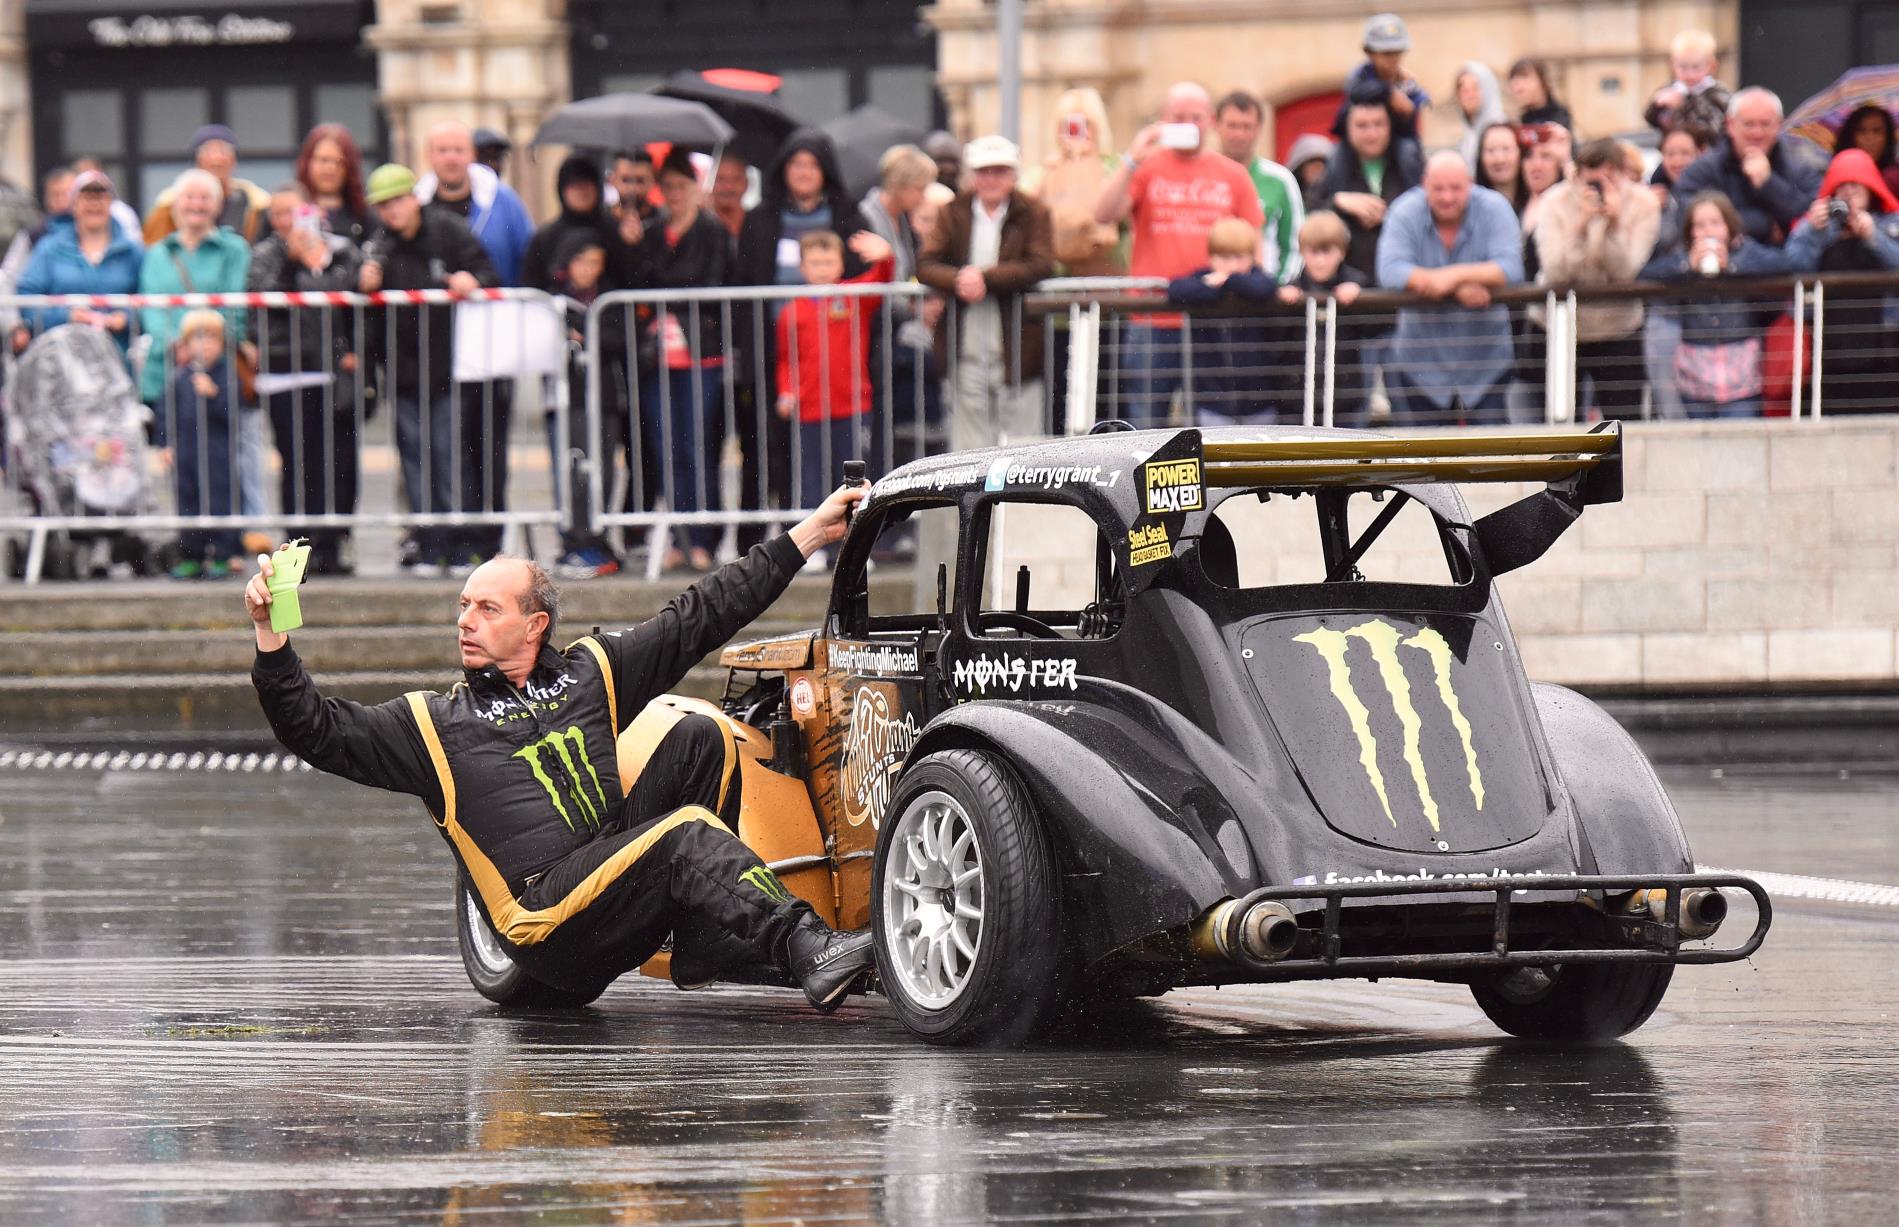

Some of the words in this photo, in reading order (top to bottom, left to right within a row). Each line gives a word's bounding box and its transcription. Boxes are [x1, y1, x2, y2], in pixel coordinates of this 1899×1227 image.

[1007, 464, 1121, 489] @terrygrant_1
[1148, 464, 1197, 488] POWER
[1149, 486, 1199, 512] MAXED
[1129, 527, 1148, 550] Steel
[1146, 521, 1168, 544] Seal
[829, 644, 919, 677] #KeepFightingMichael
[952, 652, 1078, 694] MONSTER
[474, 673, 579, 722] MOTER
[857, 753, 896, 806] STUNTS
[813, 943, 845, 965] uvex
